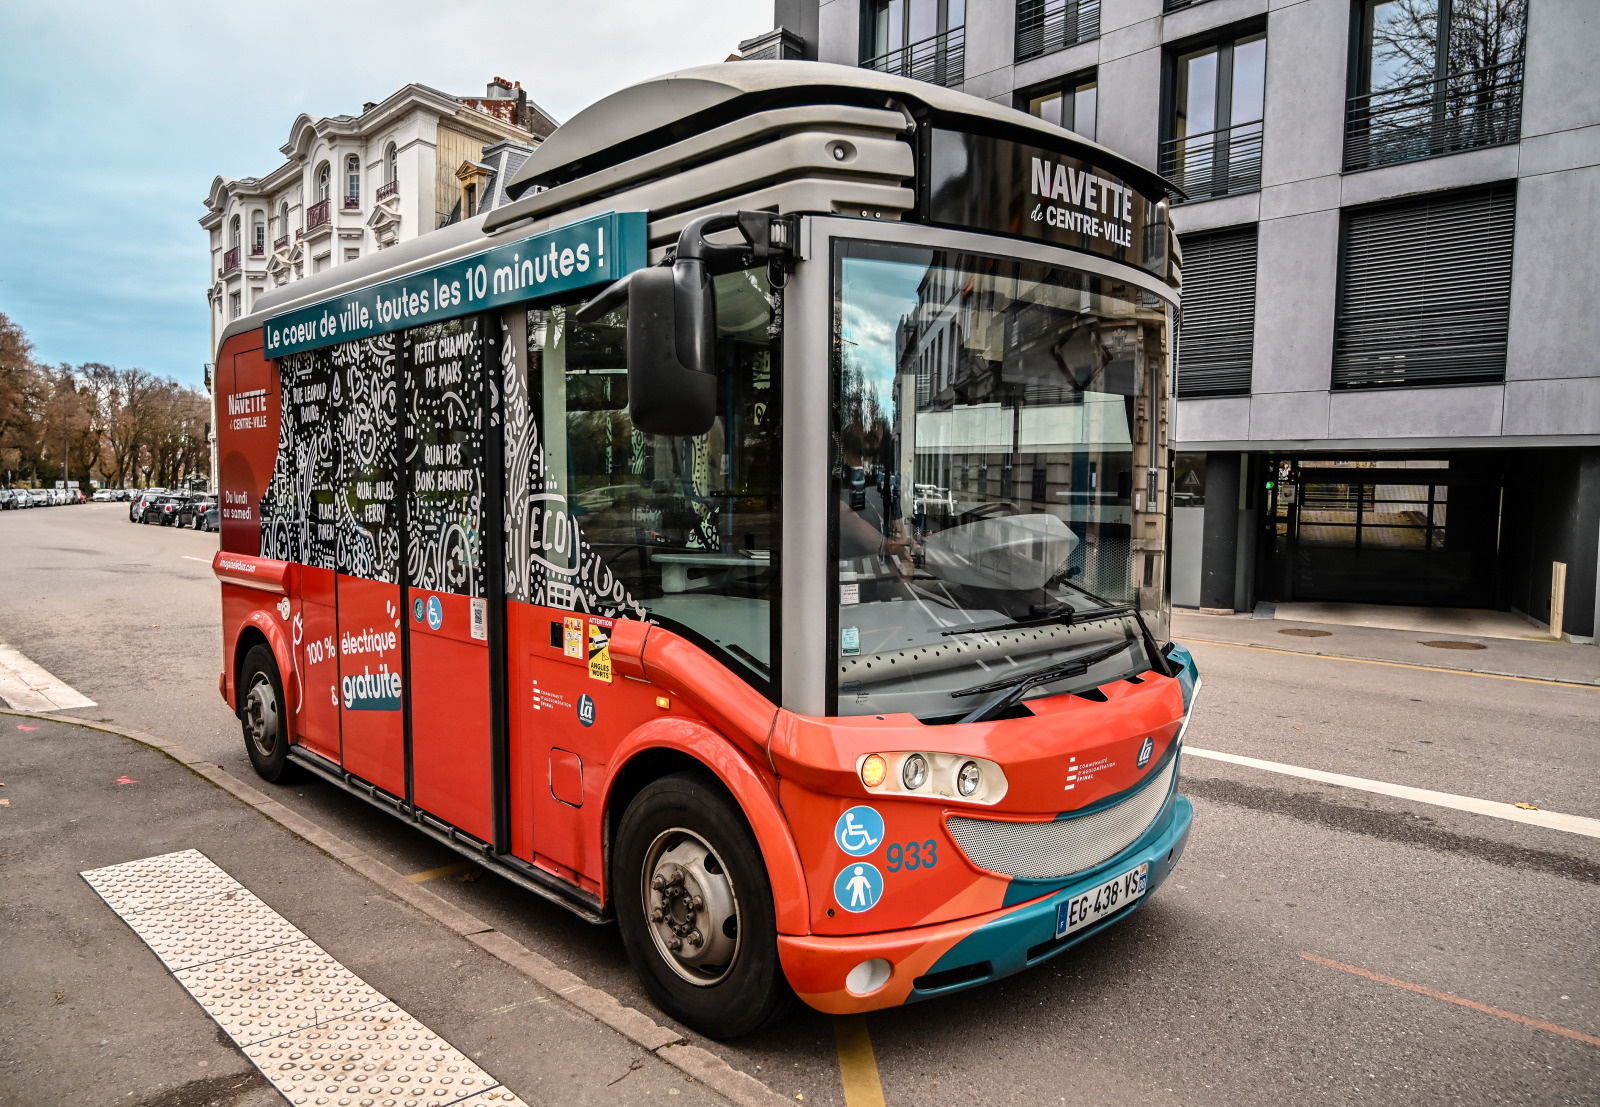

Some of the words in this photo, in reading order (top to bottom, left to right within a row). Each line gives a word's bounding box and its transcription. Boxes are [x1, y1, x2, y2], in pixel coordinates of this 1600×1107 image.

[1031, 156, 1133, 223] NAVETTE
[1030, 203, 1043, 222] de
[1046, 205, 1131, 248] CENTRE-VILLE
[267, 325, 281, 350] Le
[282, 320, 317, 346] coeur
[319, 310, 337, 338] de
[339, 301, 373, 332] ville,
[376, 287, 430, 324] toutes
[434, 278, 461, 310] les
[465, 264, 488, 302] 10
[493, 241, 590, 295] minutes
[598, 227, 604, 268] !
[438, 331, 474, 359] CHAMPS
[425, 366, 436, 389] DE
[438, 360, 462, 387] MARS
[228, 389, 267, 415] NAVETTE
[292, 386, 304, 405] RUE
[234, 415, 267, 431] CENTRE-VILLE
[445, 443, 461, 465] DES
[373, 480, 395, 501] JULES
[415, 469, 436, 492] BONS
[437, 468, 474, 492] ENFANTS
[225, 490, 233, 504] Du
[233, 490, 248, 505] lundi
[223, 508, 230, 518] au
[230, 506, 252, 520] samedi
[365, 503, 386, 525] FERRY
[530, 506, 567, 554] ECO
[588, 616, 613, 627] ATTENTION
[306, 639, 324, 665] 100
[324, 635, 336, 659] %
[341, 627, 397, 658] électrique
[590, 661, 610, 672] ANGLES
[331, 685, 339, 706] &
[342, 663, 402, 709] gratuite
[886, 839, 938, 873] 933
[1069, 869, 1140, 927] EG-438-VS
